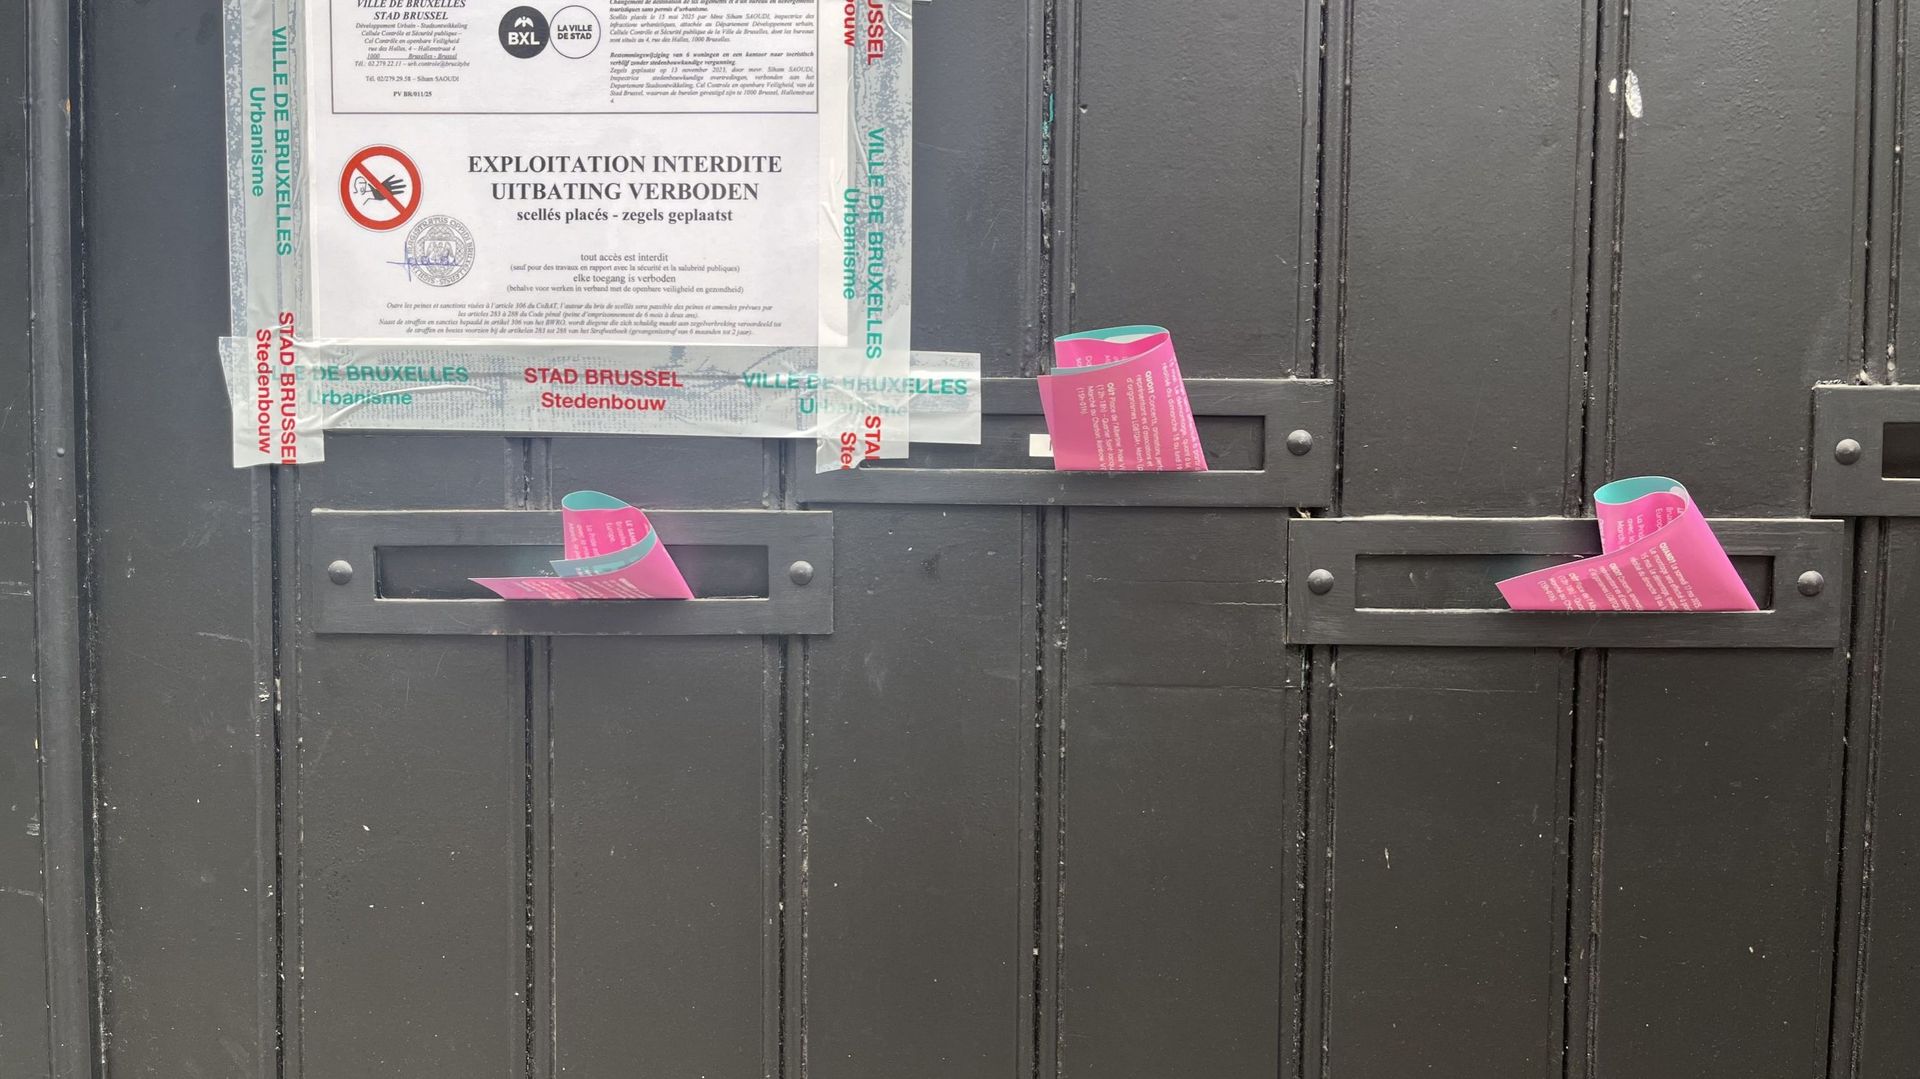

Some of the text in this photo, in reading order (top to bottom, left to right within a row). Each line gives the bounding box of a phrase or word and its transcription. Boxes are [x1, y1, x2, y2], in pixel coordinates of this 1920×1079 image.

[358, 0, 386, 8] VILLE
[406, 0, 466, 8] BRUXELLES
[374, 11, 448, 20] STAD BRUSSEL
[844, 0, 855, 46] ouw
[508, 32, 540, 45] BXL
[250, 87, 266, 196] Urbanisme
[272, 26, 291, 255] VILLE DE BRUXELLES
[469, 156, 782, 173] EXPLOITATION INTERDITE
[492, 182, 758, 200] UITBATING VERBODEN
[517, 208, 732, 224] scellés placés zegels geplaatst
[844, 189, 860, 299] Urbanisme
[867, 128, 884, 359] VILLE DE BRUXELLES
[599, 253, 622, 262] accès
[638, 253, 668, 262] interdit
[573, 274, 676, 284] elke toegang is verboden
[632, 285, 661, 294] openbare
[663, 286, 694, 294] veiligheid
[278, 312, 294, 366] STAD
[347, 366, 468, 382] BRUXELLES
[524, 368, 683, 387] STAD BRUSSEL
[743, 372, 800, 389] VILLE
[256, 329, 273, 454] Stedenbouw
[541, 392, 666, 411] Stedenbouw
[841, 432, 856, 469] Ste
